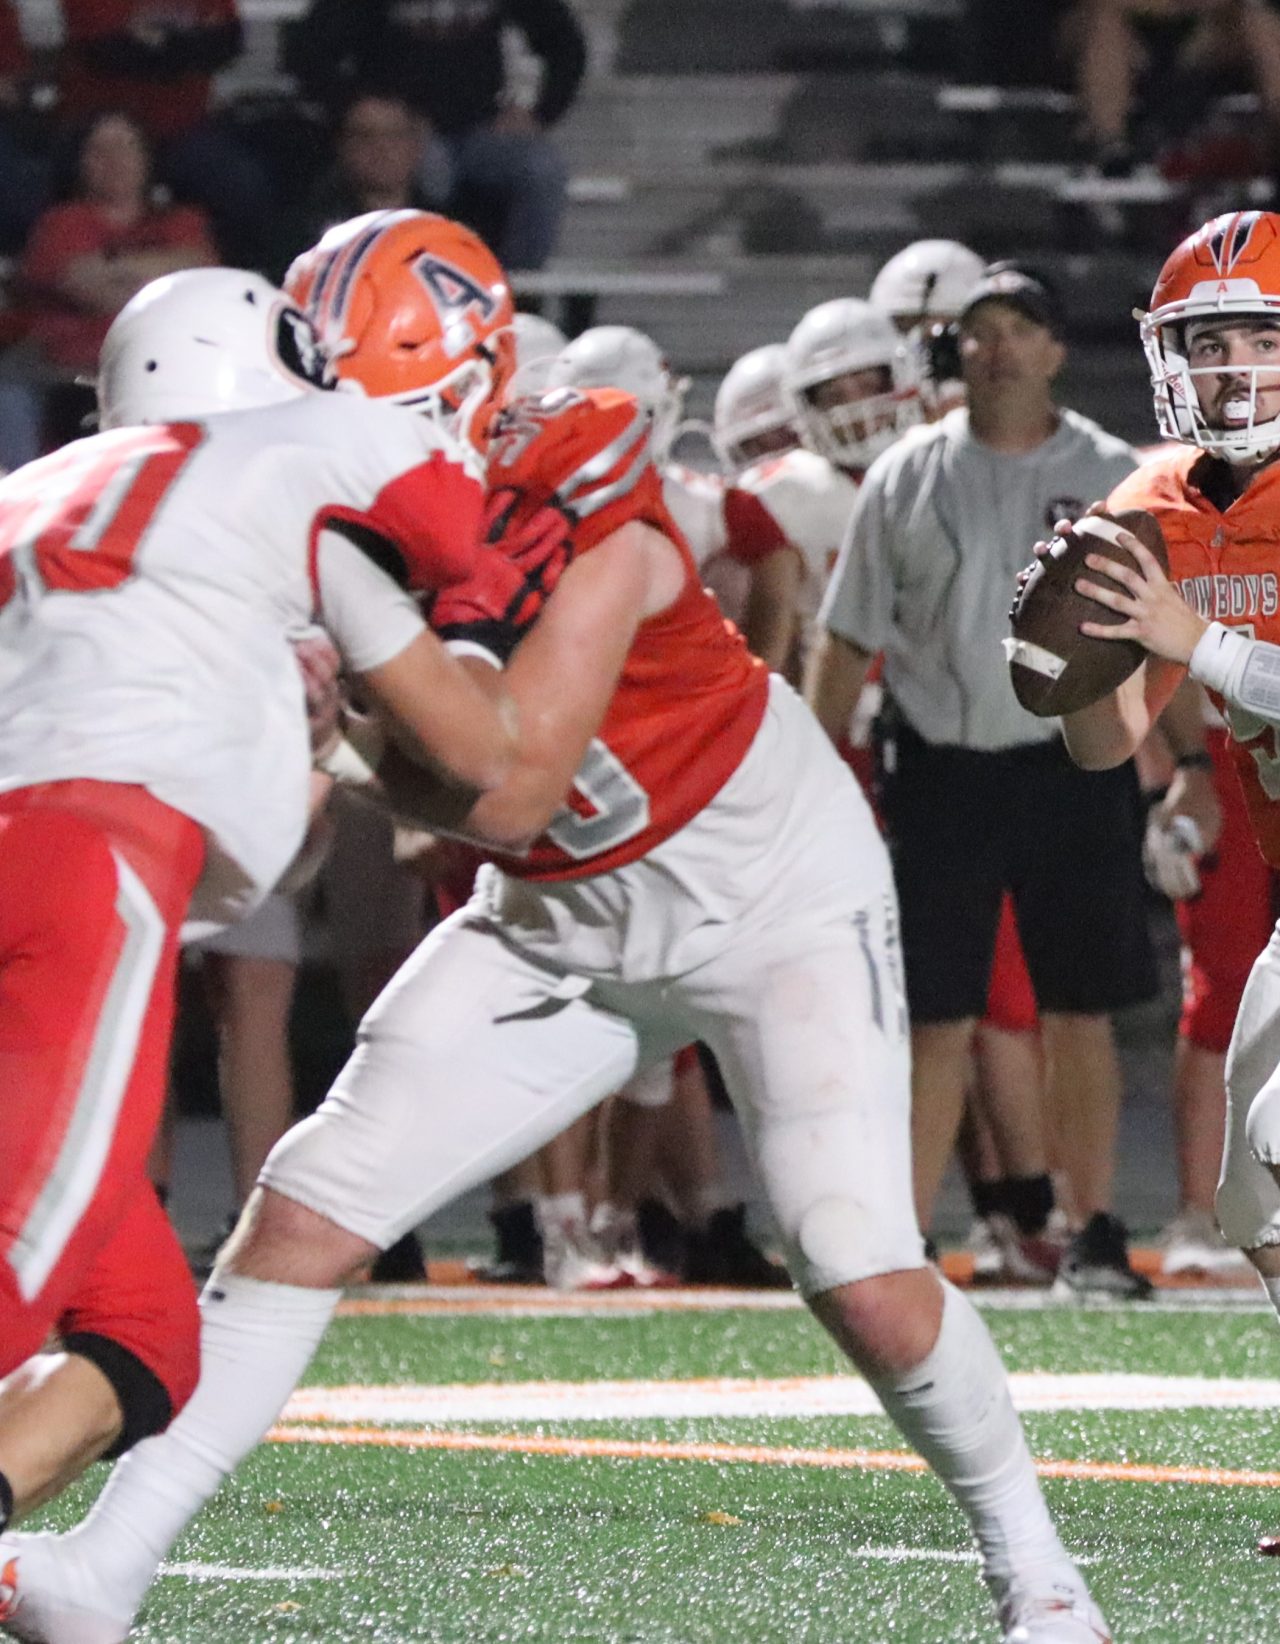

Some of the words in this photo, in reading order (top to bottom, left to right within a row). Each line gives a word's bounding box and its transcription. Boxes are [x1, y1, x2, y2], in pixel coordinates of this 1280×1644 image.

[410, 251, 503, 359] A
[1216, 281, 1228, 293] A
[1172, 572, 1279, 618] OWBOYS
